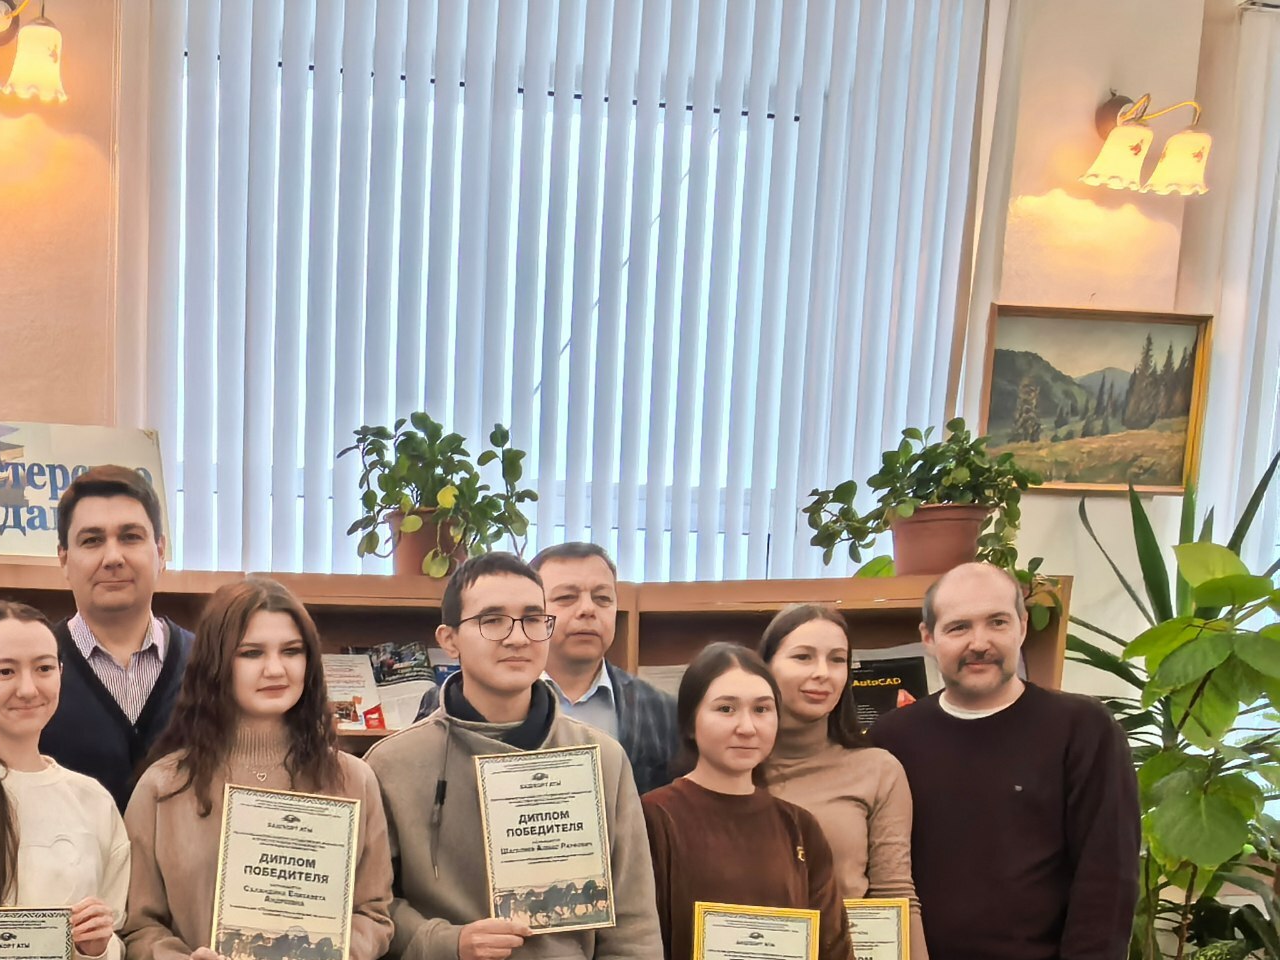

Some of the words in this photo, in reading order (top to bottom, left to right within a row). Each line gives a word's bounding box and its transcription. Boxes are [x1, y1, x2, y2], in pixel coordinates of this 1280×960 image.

[852, 677, 901, 687] AutoCAD
[518, 810, 570, 825] ДИПЛОМ
[506, 822, 584, 838] ПОБЕДИТЕЛЯ
[259, 853, 317, 868] ДИПЛОМ
[243, 865, 329, 884] ПОБЕДИТЕЛЯ
